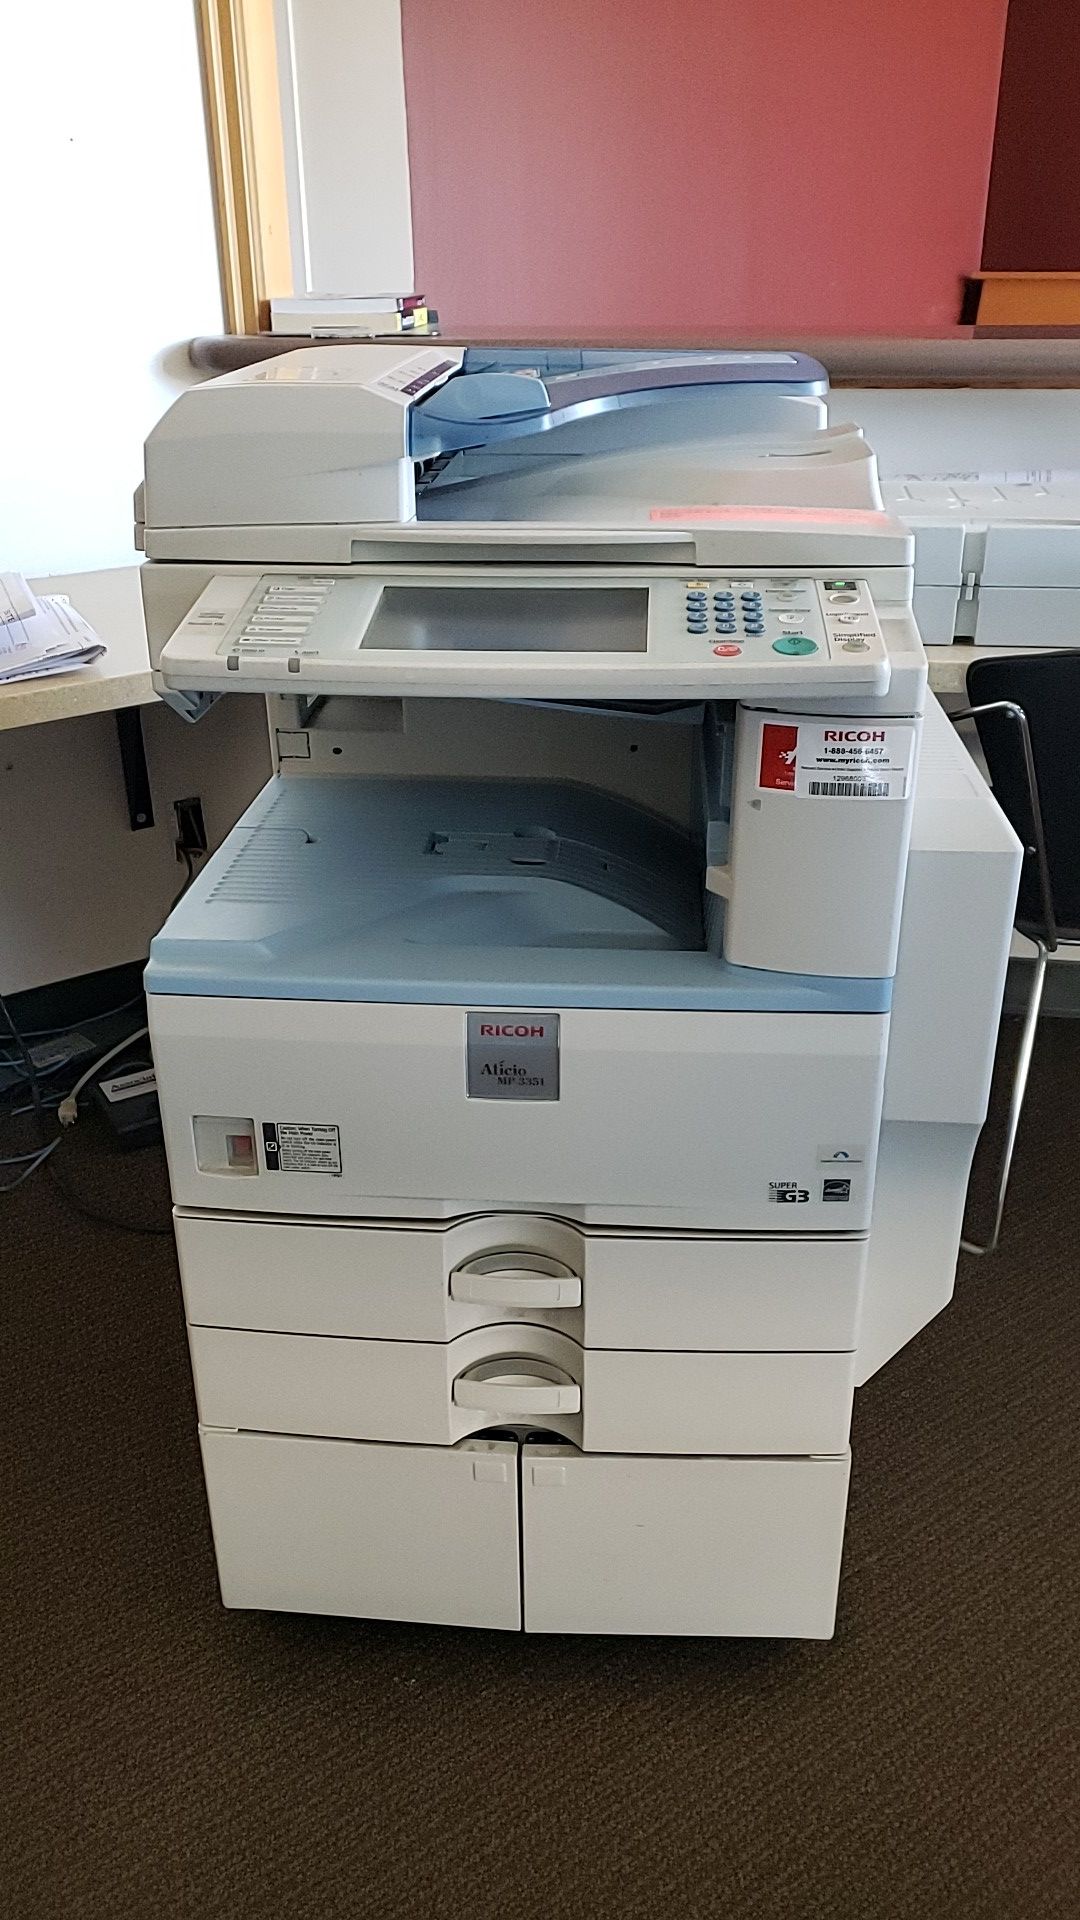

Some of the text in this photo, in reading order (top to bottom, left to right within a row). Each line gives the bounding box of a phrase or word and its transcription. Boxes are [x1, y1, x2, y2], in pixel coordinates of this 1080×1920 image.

[824, 730, 886, 742] RICOH
[824, 747, 884, 755] 1-888-4566457
[480, 1024, 544, 1038] RICOH
[498, 1077, 544, 1087] MP 3351
[768, 1181, 798, 1189] SUPER
